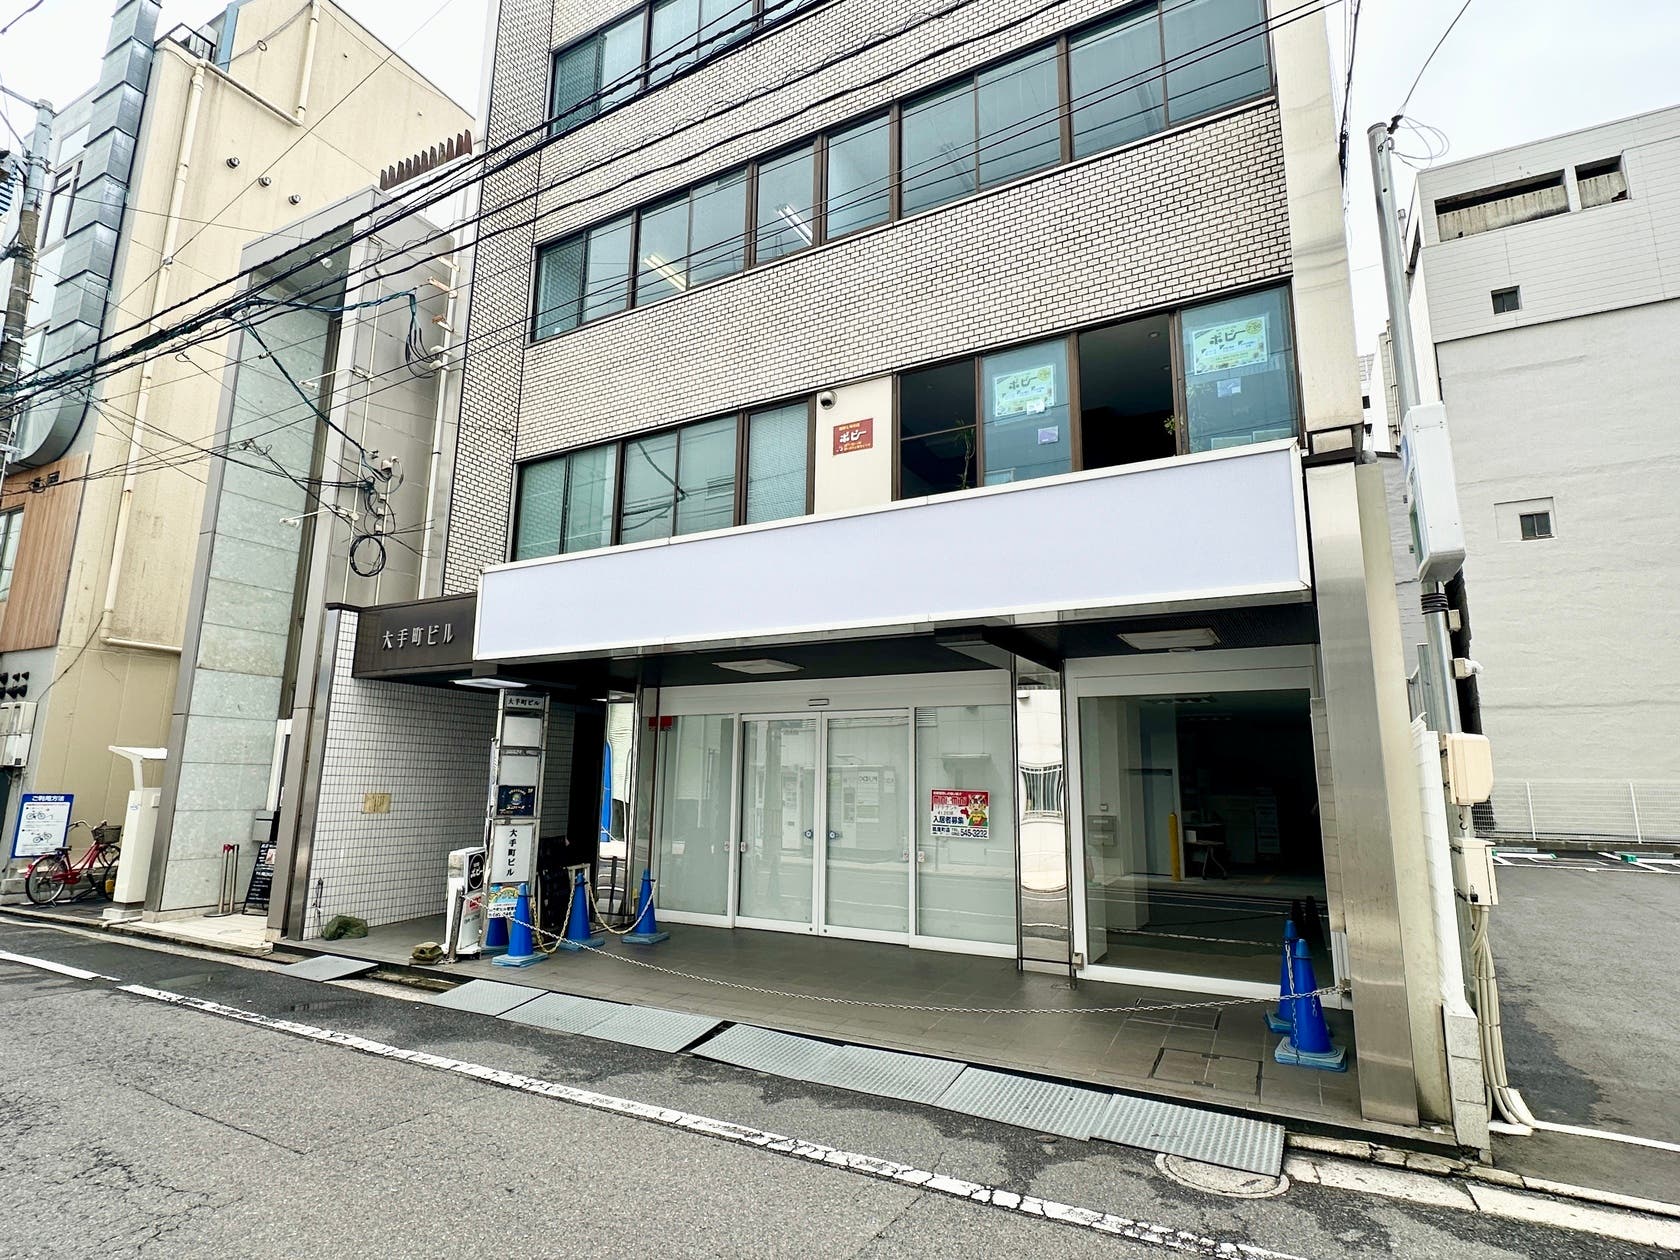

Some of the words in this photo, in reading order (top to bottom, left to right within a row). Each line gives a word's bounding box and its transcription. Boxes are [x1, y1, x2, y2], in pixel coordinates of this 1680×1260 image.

[382, 623, 454, 649] 大手町ビル
[508, 698, 541, 706] 大手町ビル
[932, 815, 964, 825] 入居者募集
[960, 828, 988, 838] 545-3232
[506, 828, 518, 877] 大手町ビル
